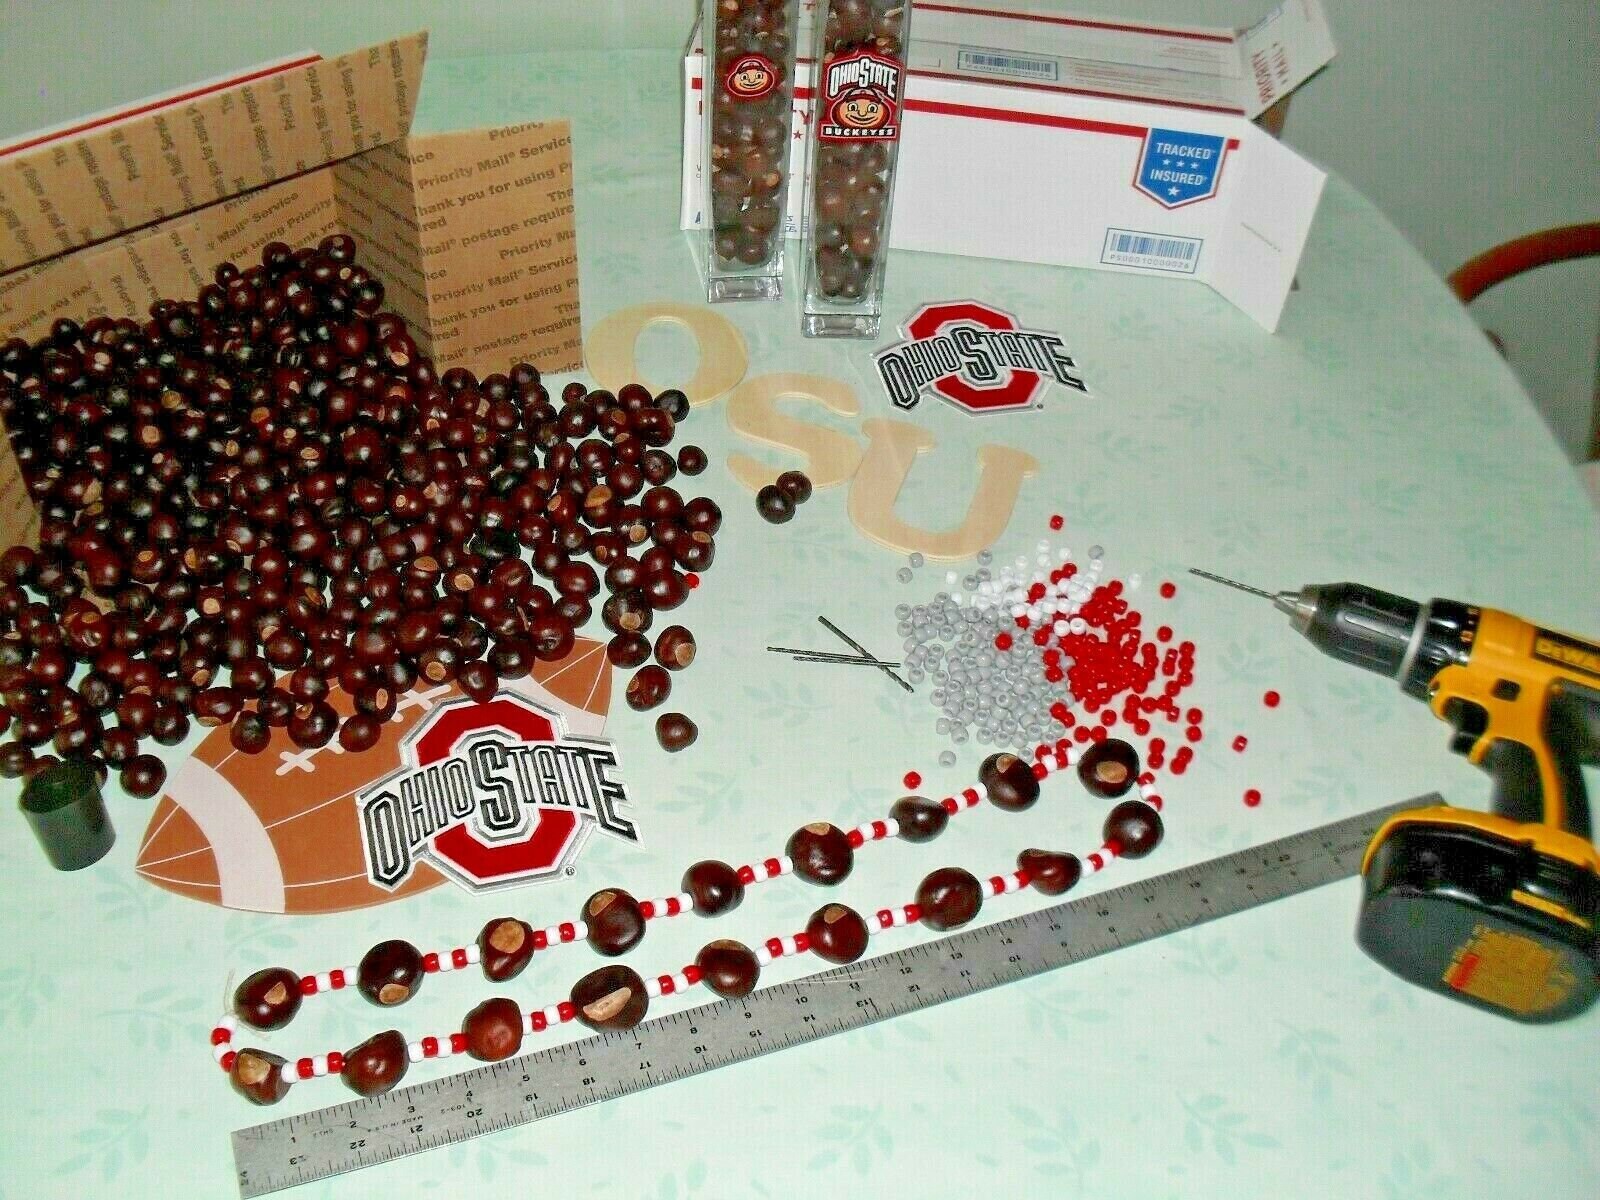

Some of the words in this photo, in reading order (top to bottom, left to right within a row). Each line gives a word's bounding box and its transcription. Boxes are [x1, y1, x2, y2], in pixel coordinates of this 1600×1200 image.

[824, 126, 894, 137] BUCKEYES
[417, 165, 473, 189] Priority
[457, 189, 485, 207] you
[488, 181, 512, 195] for
[514, 168, 556, 187] using
[461, 222, 520, 248] postage
[499, 238, 552, 260] Priority
[431, 282, 484, 303] Priority
[470, 303, 496, 319] you
[498, 295, 520, 309] for
[524, 283, 563, 301] using
[795, 996, 808, 1004] 10
[900, 967, 912, 975] 12
[950, 952, 963, 960] 13
[749, 1029, 762, 1039] 15
[639, 1060, 651, 1070] 17
[582, 1077, 596, 1087] 18
[525, 1092, 539, 1103] 19
[466, 1108, 484, 1118] 20
[409, 1124, 423, 1134] 21
[350, 1139, 366, 1150] 22
